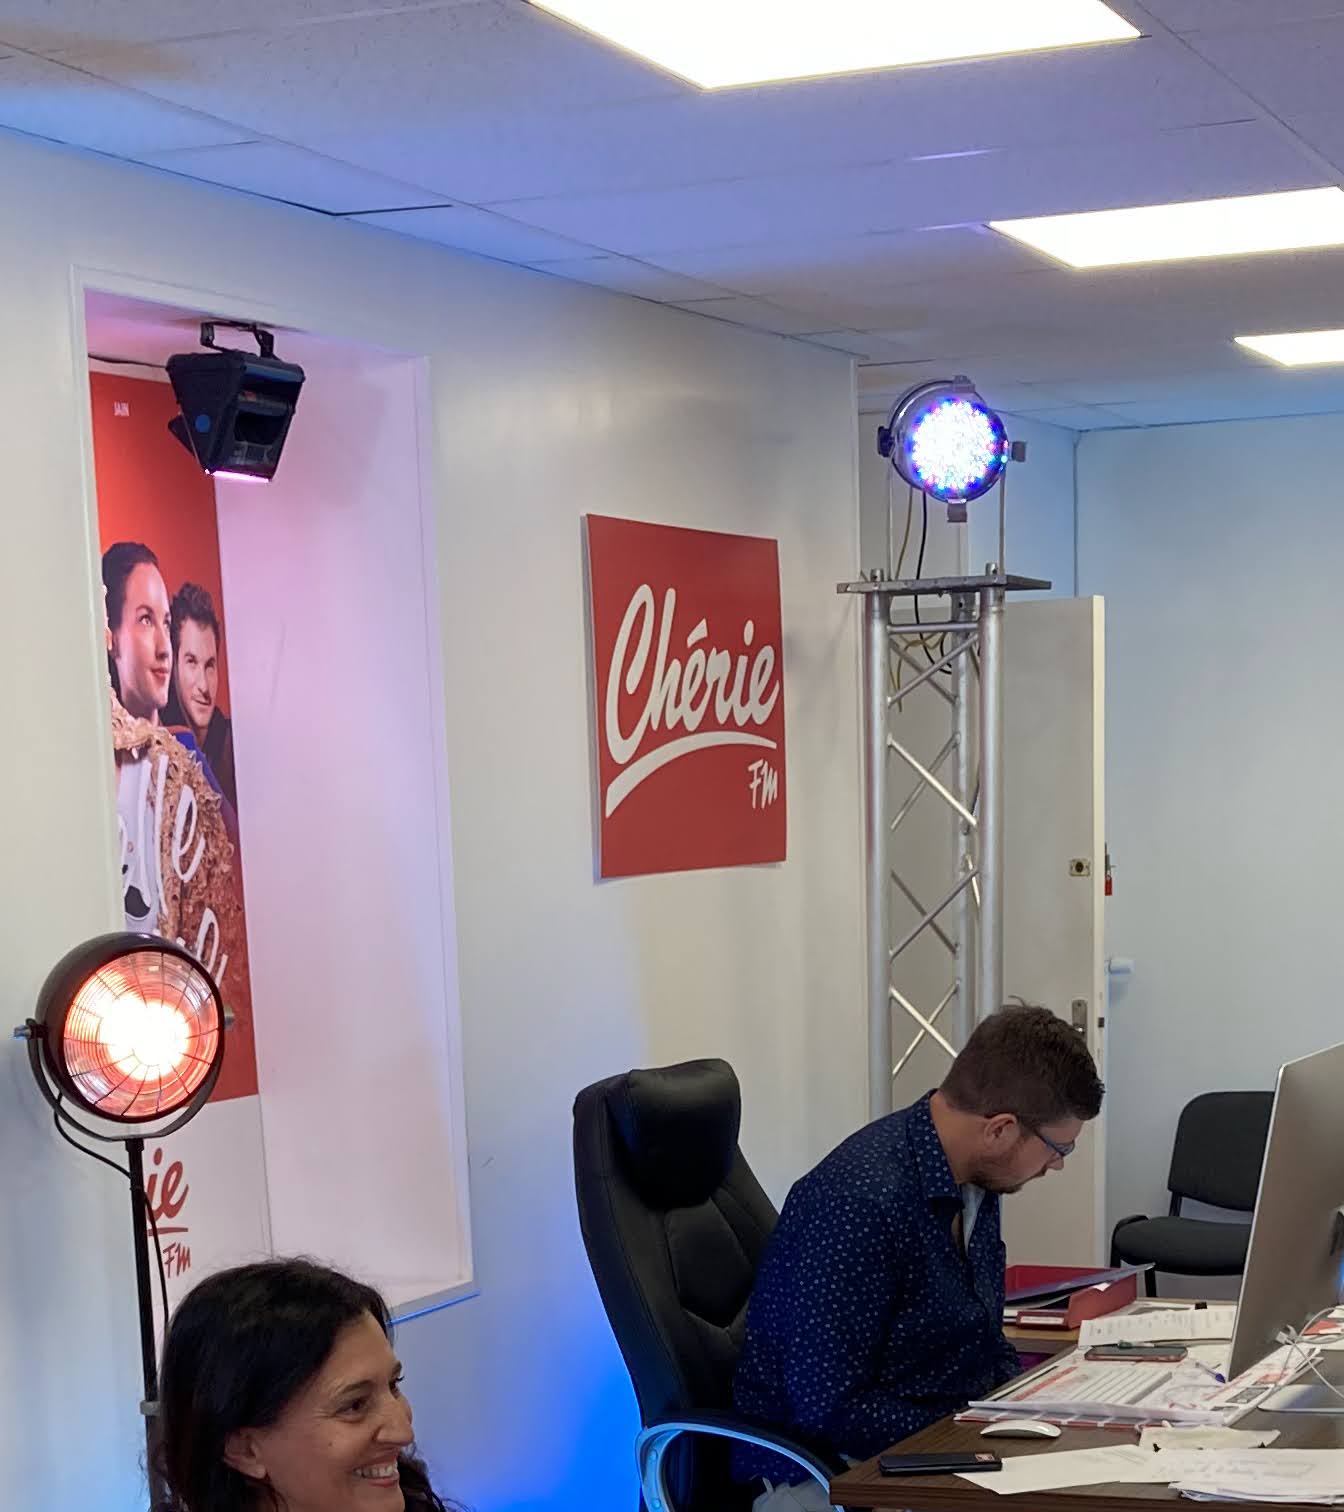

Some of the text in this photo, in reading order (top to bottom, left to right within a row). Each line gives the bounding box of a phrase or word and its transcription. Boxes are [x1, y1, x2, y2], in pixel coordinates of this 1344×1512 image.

[606, 584, 780, 764] Chérie
[748, 759, 779, 809] FM
[163, 1242, 191, 1278] FM
